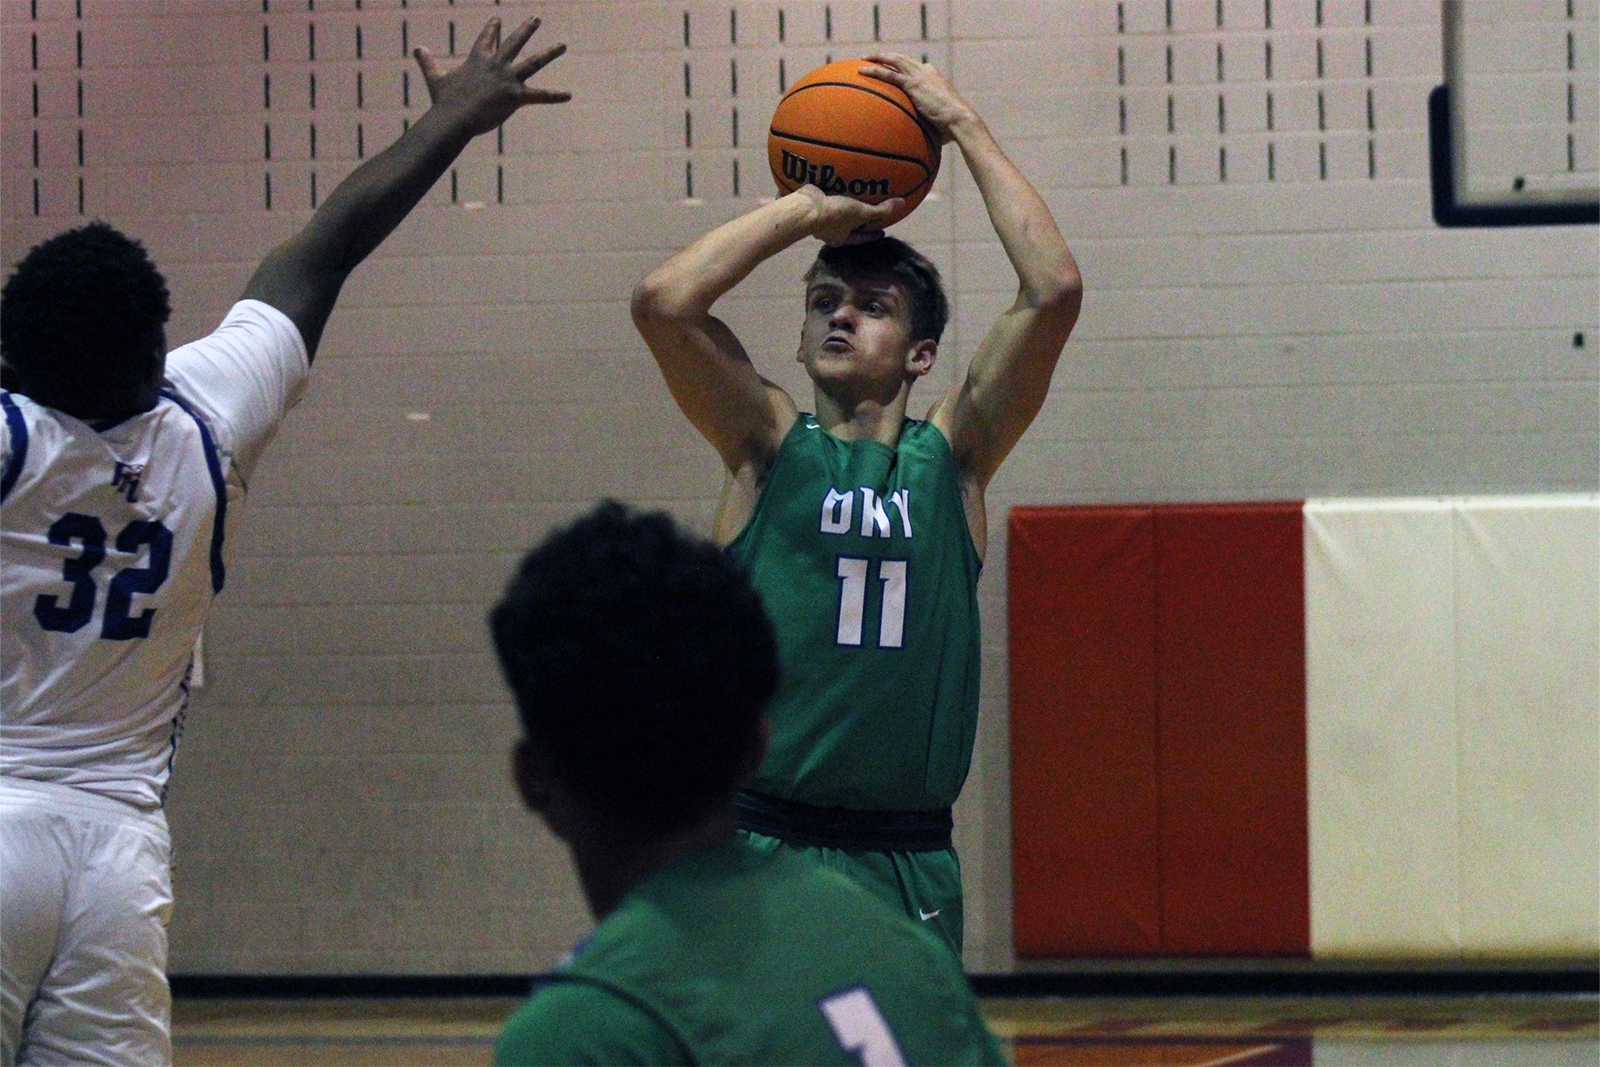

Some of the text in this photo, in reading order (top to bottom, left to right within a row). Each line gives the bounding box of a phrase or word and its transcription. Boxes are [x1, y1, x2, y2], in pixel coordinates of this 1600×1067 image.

[781, 148, 890, 196] Wilson
[33, 511, 174, 641] 32
[835, 556, 908, 648] 11
